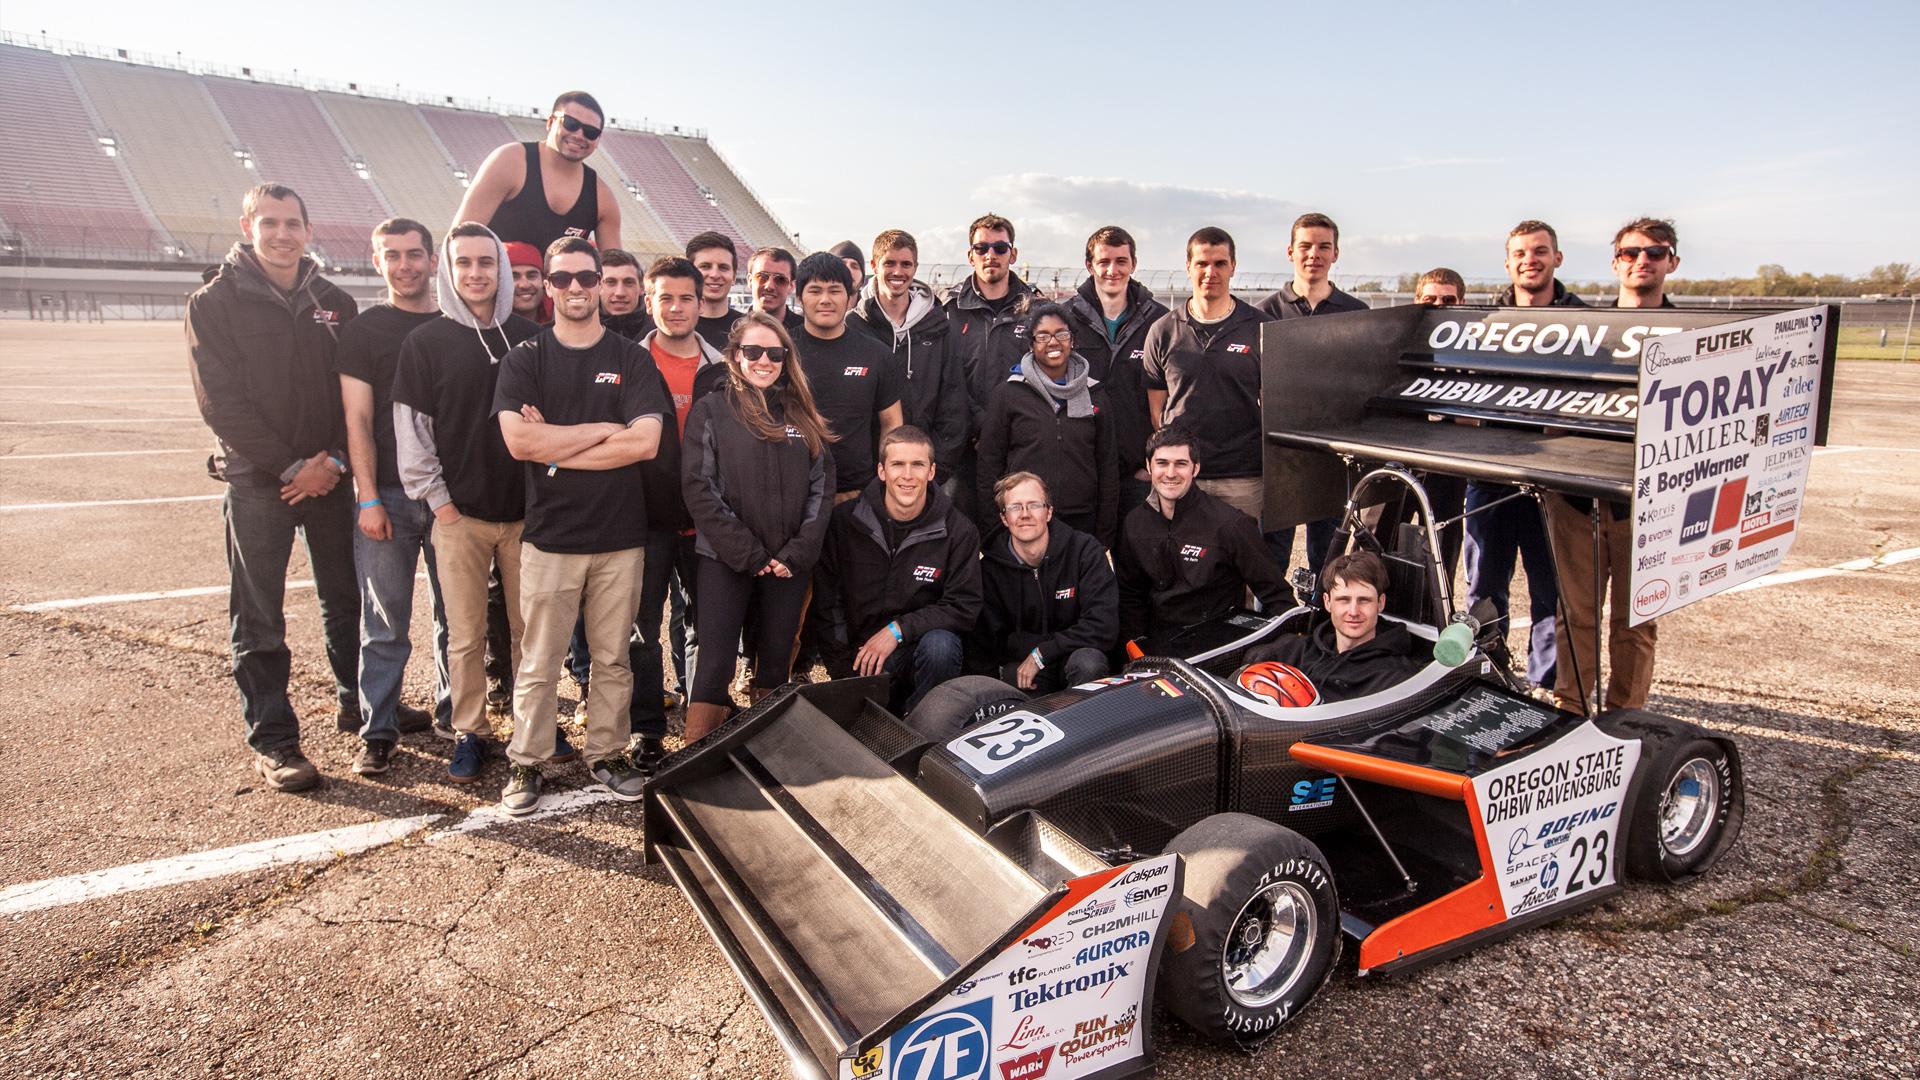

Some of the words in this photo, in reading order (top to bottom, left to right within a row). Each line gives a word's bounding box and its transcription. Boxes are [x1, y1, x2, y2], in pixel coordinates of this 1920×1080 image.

[1775, 316, 1809, 335] PANALPINA
[1428, 321, 1608, 357] OREGON
[1612, 326, 1683, 358] ST
[1696, 328, 1754, 355] FUTEK
[1400, 378, 1503, 405] DHBW
[1499, 386, 1637, 419] RAVENS
[1778, 402, 1811, 421] AIRTECH
[1640, 419, 1748, 470] DAIMLER
[1772, 426, 1807, 447] FESTO
[1657, 453, 1749, 493] BorgWarner
[1648, 504, 1676, 523] Korvis
[1743, 514, 1769, 532] MOTUL
[1682, 520, 1708, 538] mtu
[1735, 548, 1779, 571] handtmann
[1636, 587, 1668, 608] Henkel
[964, 718, 1044, 761] 23
[1488, 760, 1570, 801] OREGON
[1574, 745, 1625, 778] STATE
[1291, 777, 1337, 804] SAE
[1486, 792, 1533, 825] DHBW
[1535, 766, 1622, 811] RAVENSBURG
[1536, 801, 1618, 840] BOEING
[1125, 865, 1169, 884] Calspan
[1506, 847, 1562, 875] SPACEX
[1565, 829, 1609, 895] 23
[1133, 884, 1168, 903] SMP
[1067, 905, 1095, 917] PORTLAND
[1075, 929, 1151, 966] AURORA
[1008, 966, 1038, 986] tfc
[1038, 963, 1072, 978] PLATING
[1008, 962, 1130, 1013] Tektronix
[997, 1014, 1046, 1051] Linn
[1031, 1032, 1051, 1042] GEAR
[1058, 1018, 1138, 1057] COUNTRY
[1073, 1014, 1108, 1039] FUN
[1065, 1037, 1128, 1068] Powersports
[1010, 1058, 1044, 1080] WARN
